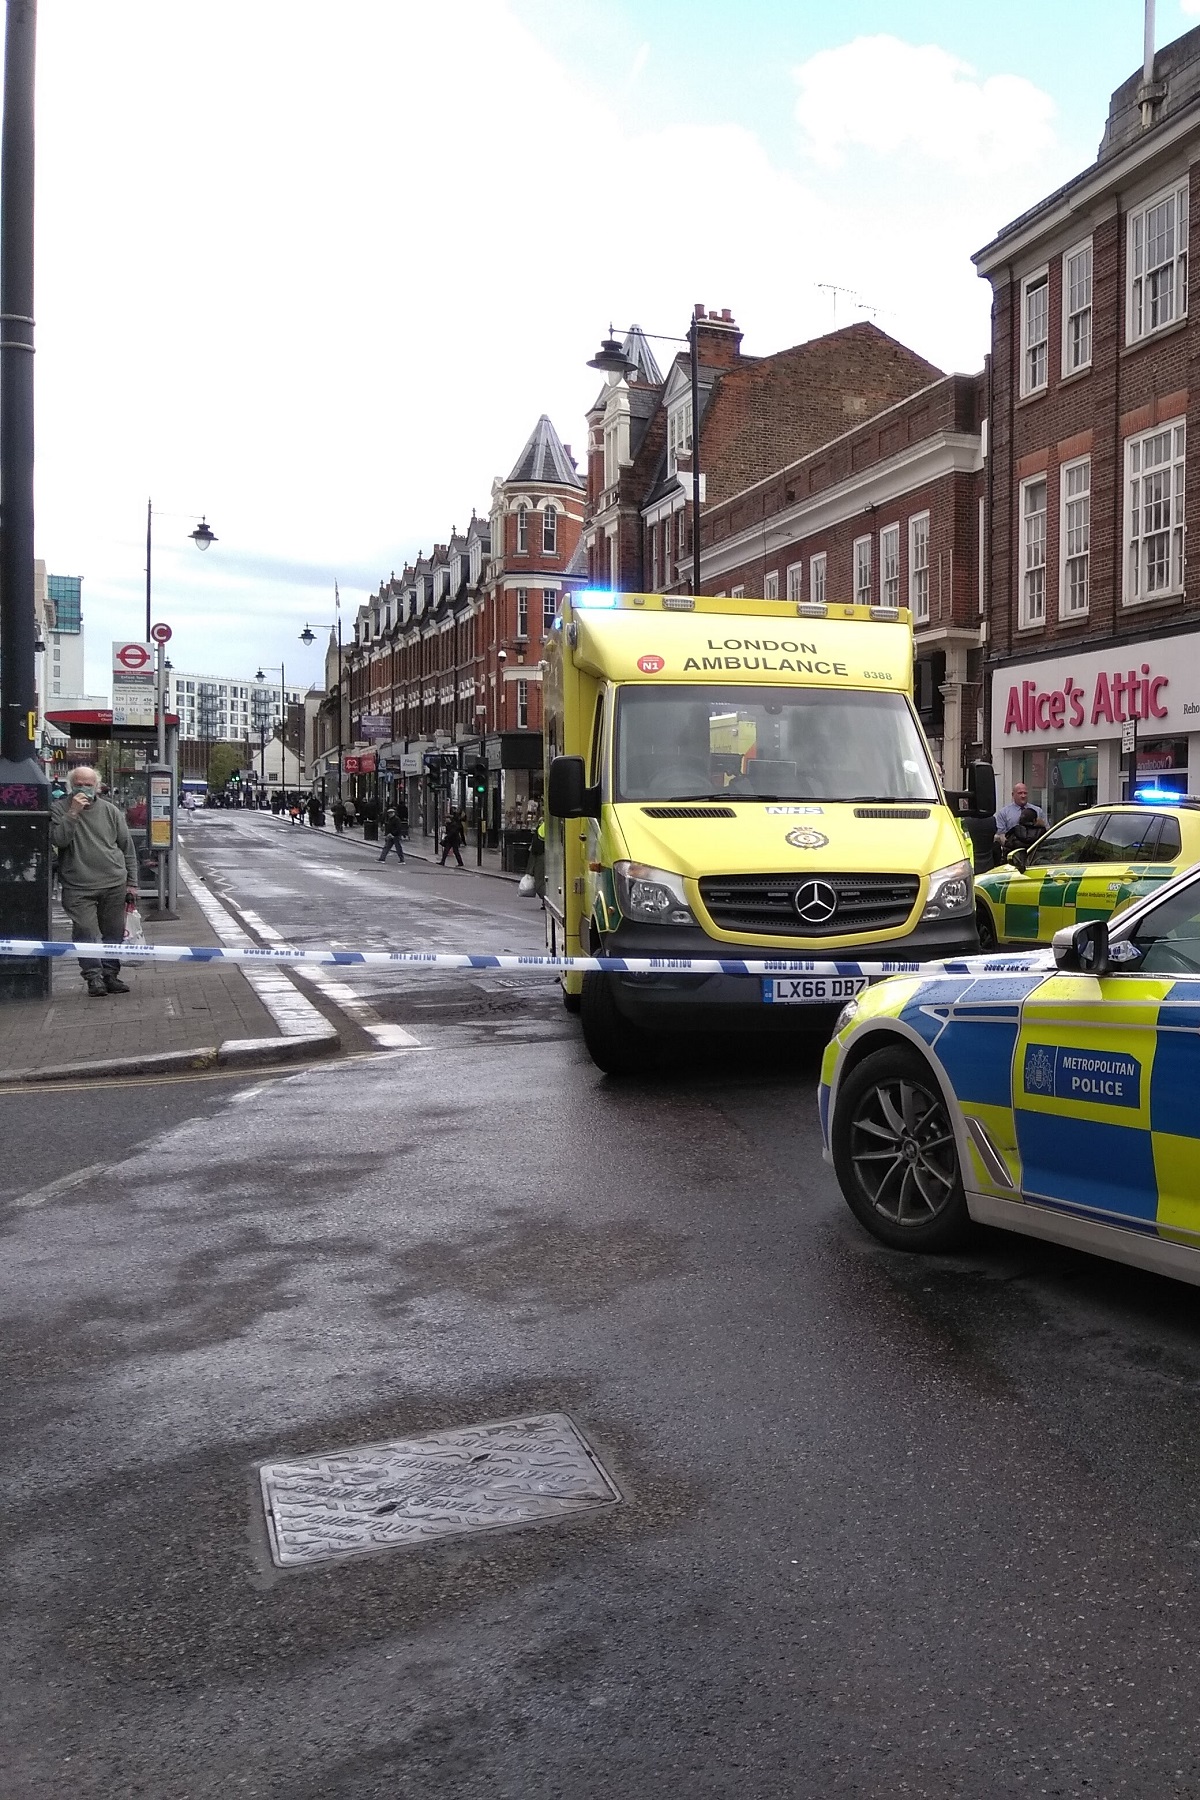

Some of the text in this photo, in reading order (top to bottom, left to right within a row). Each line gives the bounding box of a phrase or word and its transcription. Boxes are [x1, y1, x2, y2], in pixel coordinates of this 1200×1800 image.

[153, 624, 168, 640] C
[707, 638, 818, 655] LONDON
[642, 661, 658, 671] N1
[682, 656, 849, 677] AMBULANCE
[863, 670, 893, 681] 8388
[1003, 663, 1169, 735] Alice's Attic
[767, 806, 822, 815] NHS
[776, 981, 826, 998] LX66
[1062, 1056, 1135, 1076] METROPOLITAN
[1071, 1076, 1123, 1097] POLICE
